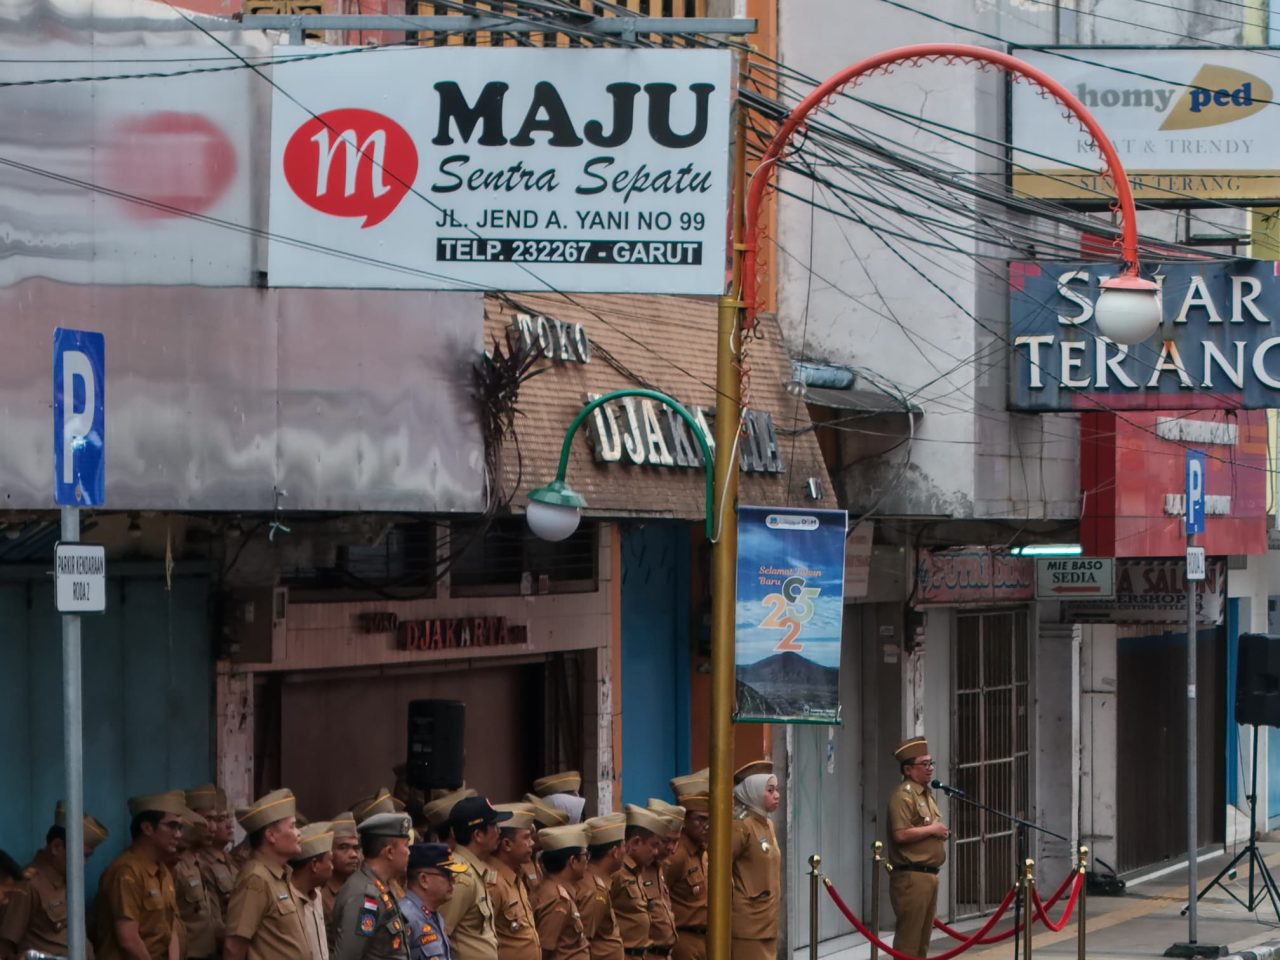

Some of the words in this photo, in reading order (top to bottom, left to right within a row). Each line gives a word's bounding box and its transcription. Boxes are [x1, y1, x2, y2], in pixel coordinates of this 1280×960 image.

[1076, 83, 1175, 112] homy
[1189, 82, 1253, 113] ped
[431, 80, 716, 148] MAJU
[1165, 139, 1254, 154] TRENDY
[431, 154, 560, 194] Sentra
[575, 156, 713, 203] Sepatu
[1080, 176, 1144, 191] SINR
[1153, 176, 1241, 192] TERANG
[435, 208, 468, 229] JL.
[476, 209, 538, 229] JEND
[546, 211, 568, 229] A.
[576, 210, 630, 230] YANI
[638, 211, 672, 231] NO
[679, 211, 705, 231] 99
[441, 239, 504, 261] TELP.
[511, 240, 591, 262] 232267
[613, 242, 698, 264] GARUT
[1057, 271, 1271, 325] SAR
[513, 314, 591, 363] TOKO
[63, 351, 95, 484] P
[1189, 459, 1203, 524] P
[58, 555, 75, 575] PARKIR
[759, 566, 793, 576] Selamat
[1046, 561, 1070, 571] MIE
[1073, 560, 1104, 571] BASO
[758, 576, 781, 586] Baru
[1052, 572, 1097, 584] SEDIA
[73, 581, 86, 601] RODA
[405, 616, 509, 650] DJAKARTA
